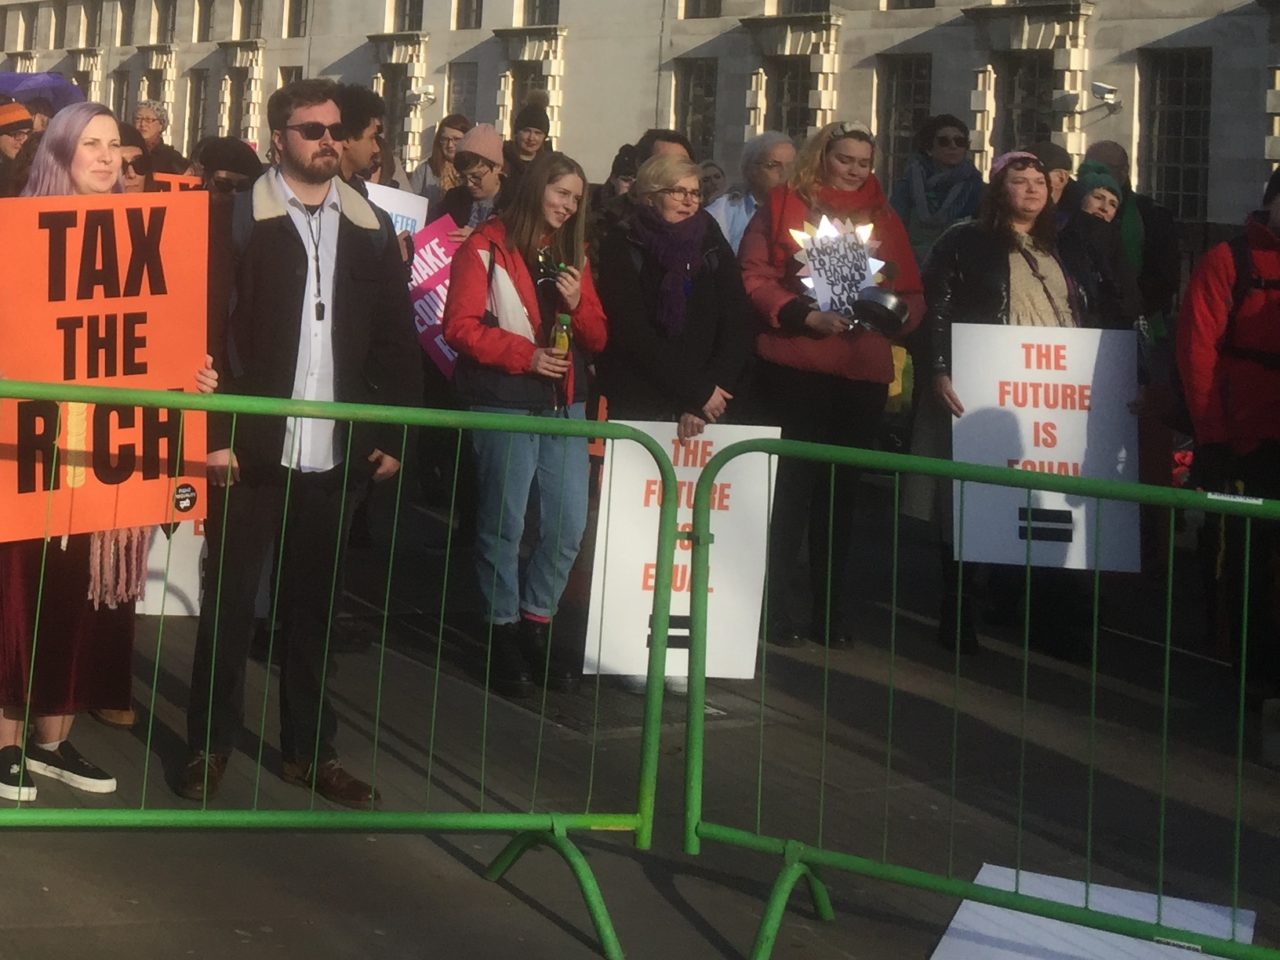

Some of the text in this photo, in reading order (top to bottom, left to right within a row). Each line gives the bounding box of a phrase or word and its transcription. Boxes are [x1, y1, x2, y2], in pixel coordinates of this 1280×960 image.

[38, 206, 168, 302] TAX
[56, 311, 148, 381] THE
[1022, 343, 1067, 371] THE
[998, 381, 1091, 412] FUTURE
[1033, 421, 1057, 448] IS
[672, 439, 713, 467] THE
